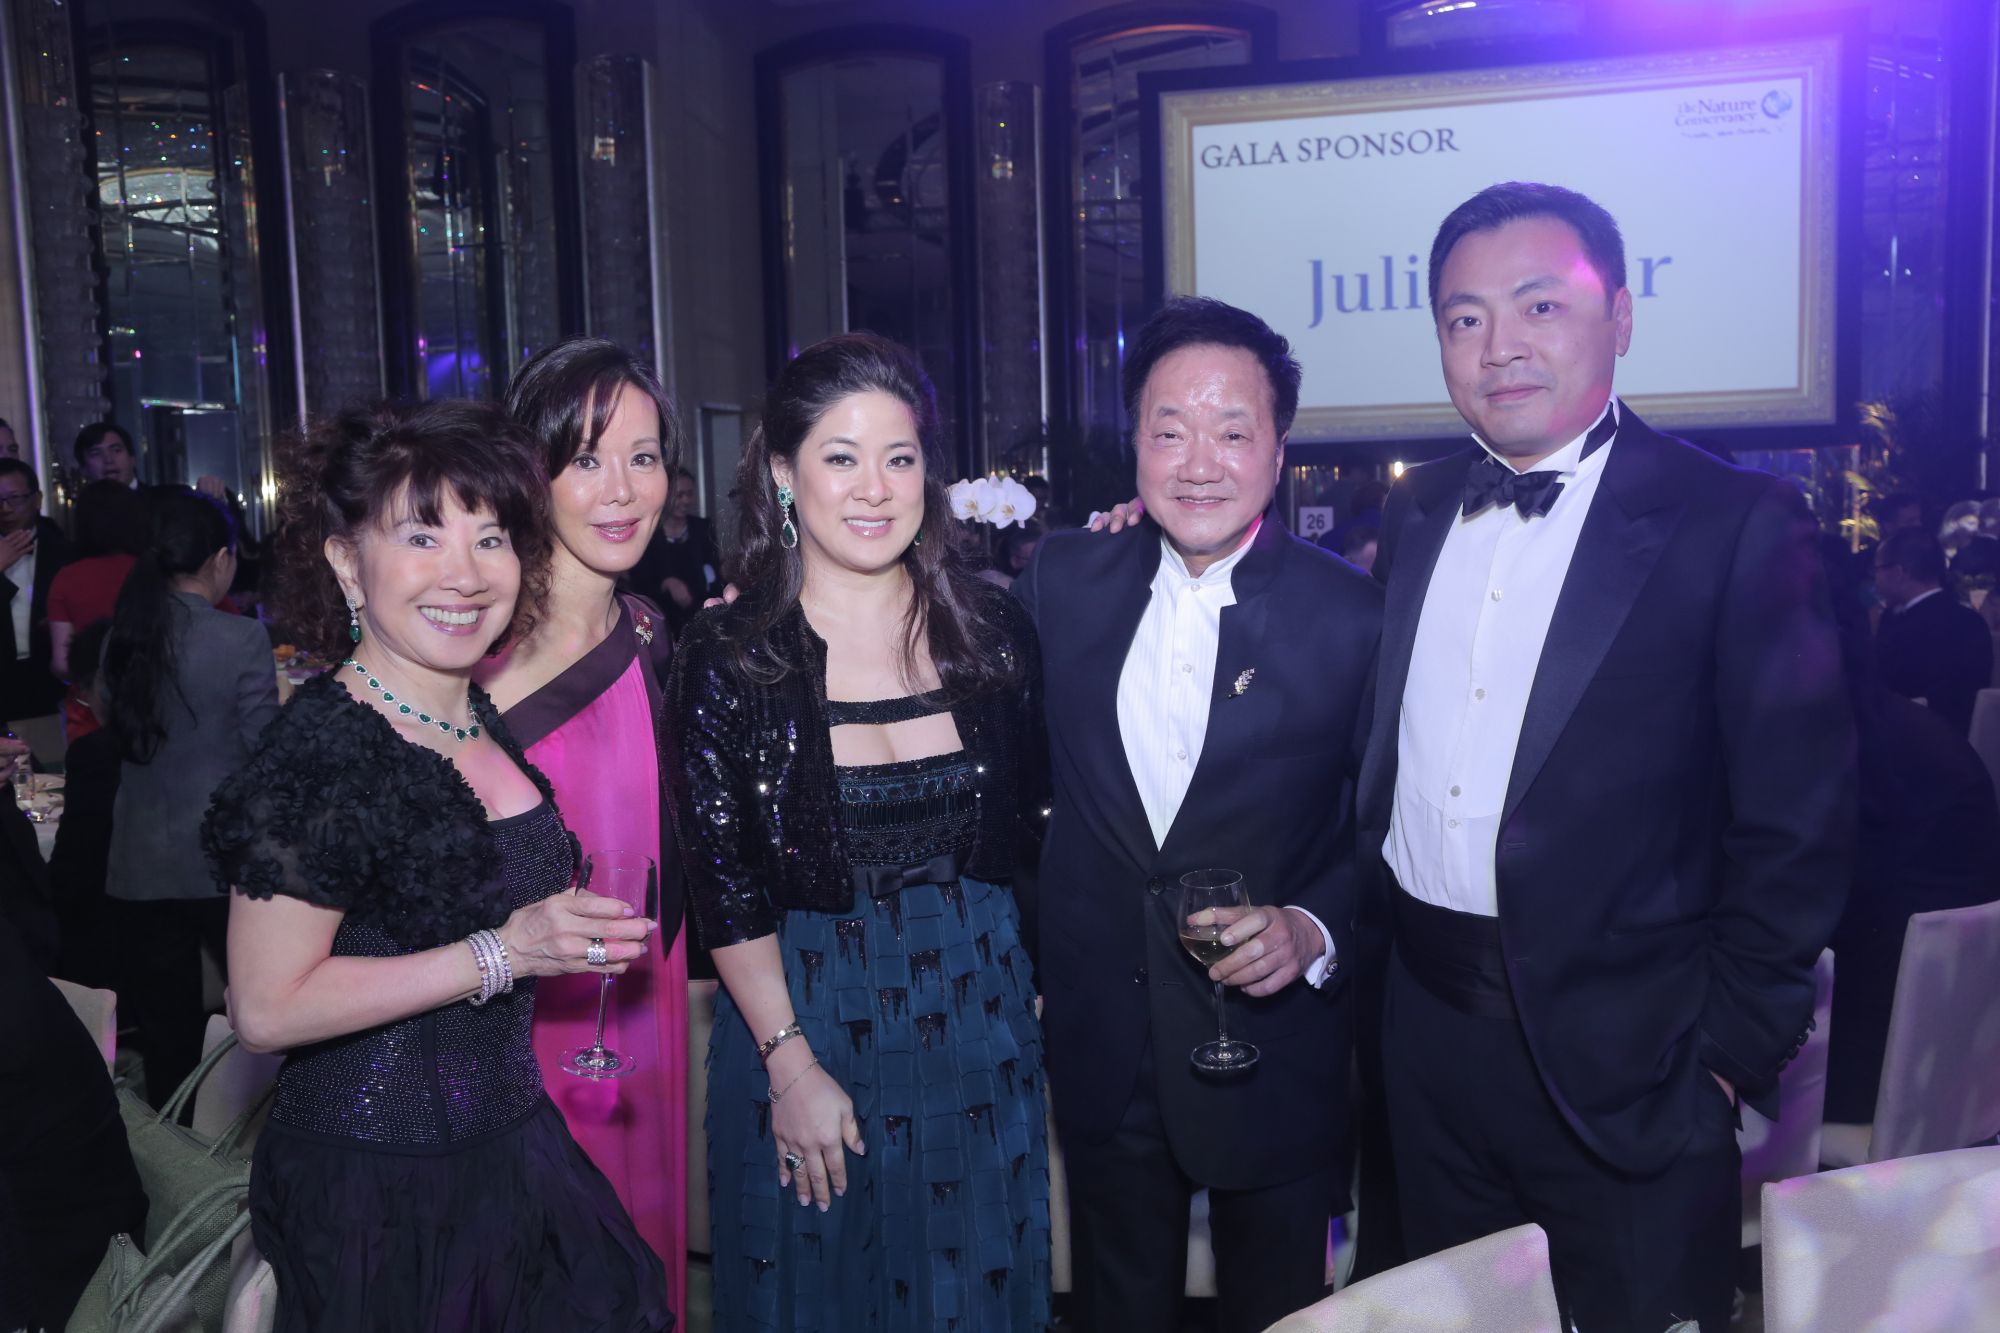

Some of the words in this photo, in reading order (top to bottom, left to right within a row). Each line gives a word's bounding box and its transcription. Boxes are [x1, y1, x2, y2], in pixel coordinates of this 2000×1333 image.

[1698, 98, 1756, 113] Nature
[1201, 141, 1289, 169] GALA
[1296, 128, 1460, 163] SPONSOR
[1307, 253, 1423, 329] Juli
[1306, 513, 1325, 530] 26
